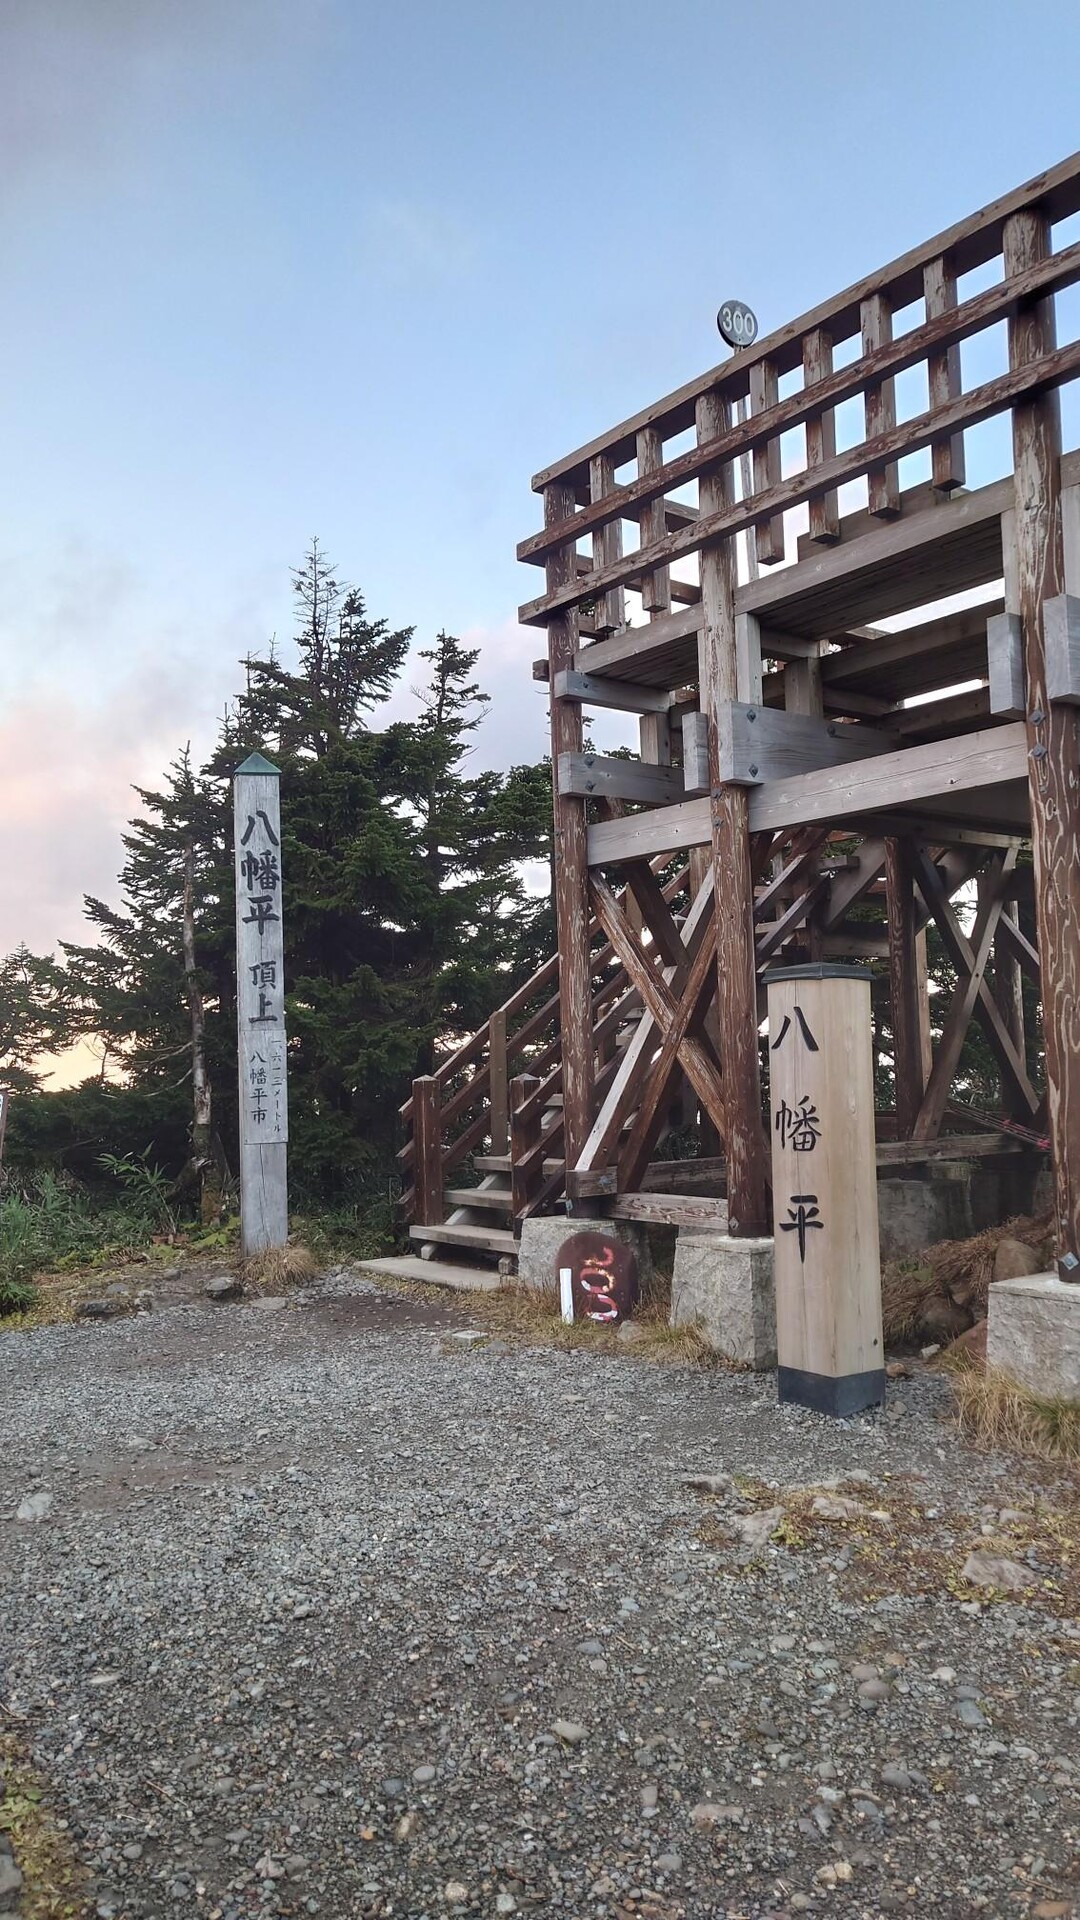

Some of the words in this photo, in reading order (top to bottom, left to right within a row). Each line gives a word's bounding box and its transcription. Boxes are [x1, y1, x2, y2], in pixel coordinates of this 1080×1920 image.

[722, 307, 755, 337] 300
[240, 810, 280, 935] 八幡平
[248, 960, 278, 1023] 頂上
[249, 1050, 268, 1125] 八幡平市
[771, 1006, 824, 1263] 八幡平
